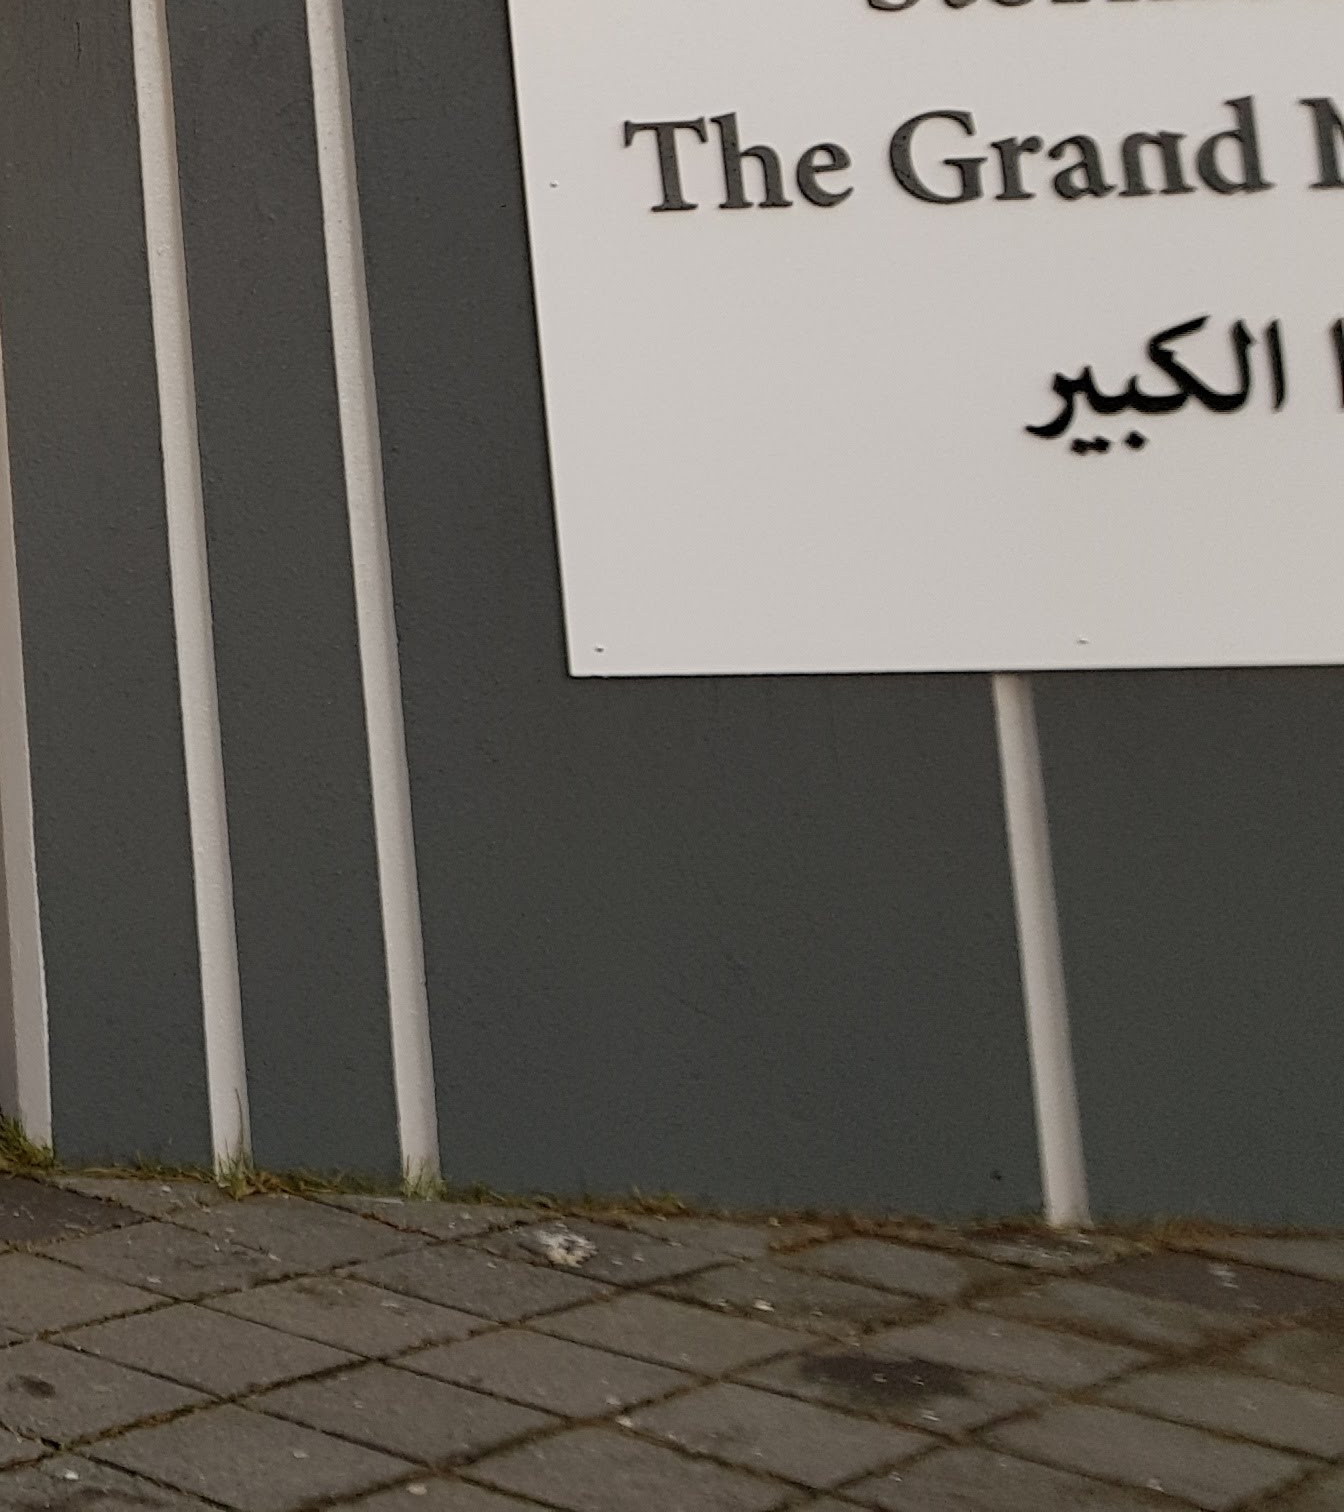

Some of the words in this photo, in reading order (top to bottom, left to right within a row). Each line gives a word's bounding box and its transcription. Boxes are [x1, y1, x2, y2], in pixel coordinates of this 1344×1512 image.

[624, 112, 855, 215] The
[887, 95, 1273, 205] Grand
[1025, 314, 1286, 455] الكبير
